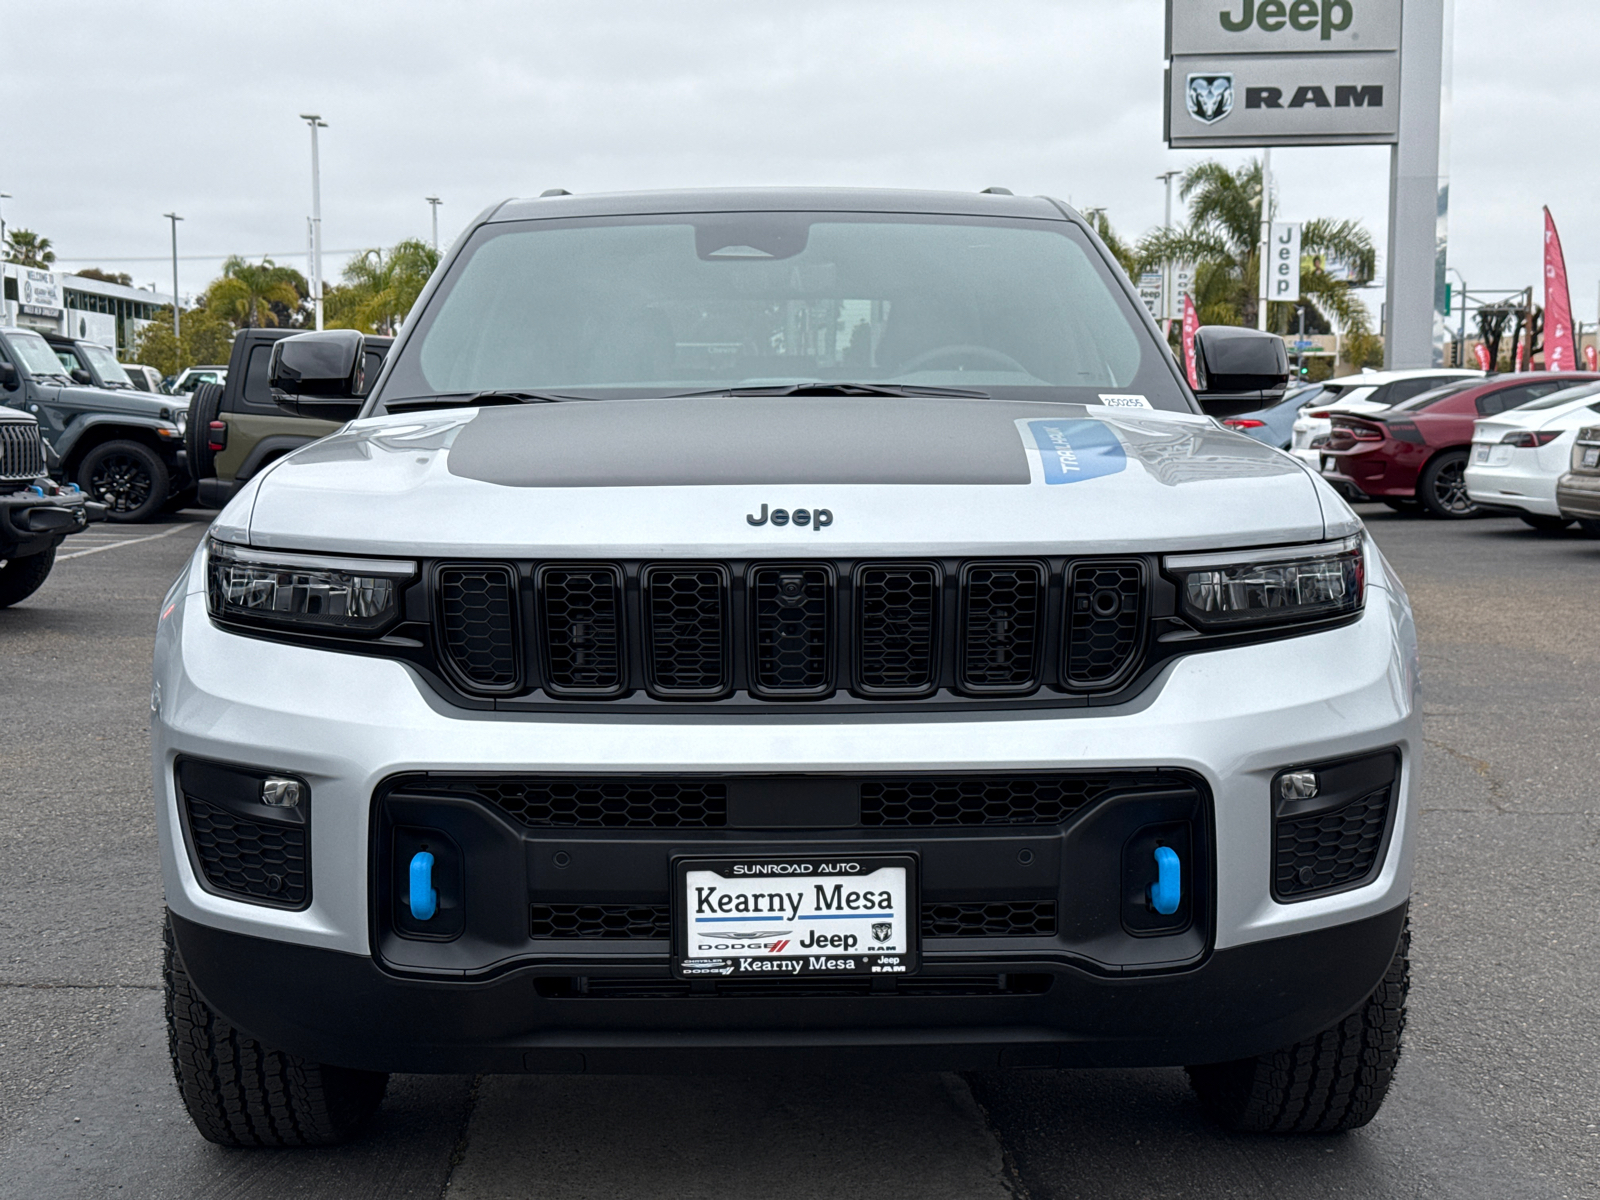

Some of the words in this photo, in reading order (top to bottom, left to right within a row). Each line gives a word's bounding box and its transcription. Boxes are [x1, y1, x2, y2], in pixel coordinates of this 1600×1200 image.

[1219, 0, 1353, 40] Jeep
[1245, 85, 1383, 109] RAM
[1277, 227, 1293, 295] Jeep
[1140, 289, 1160, 299] Jeep
[746, 503, 834, 531] Jeep
[733, 864, 813, 875] SUNROAD
[818, 862, 860, 873] AUTO
[695, 887, 803, 921] Kearny
[814, 884, 894, 911] Mesa
[698, 942, 777, 951] DODGE
[800, 929, 858, 951] Jeep
[739, 958, 803, 974] Kearny
[809, 957, 855, 970] Mesa
[877, 956, 900, 965] Jeep
